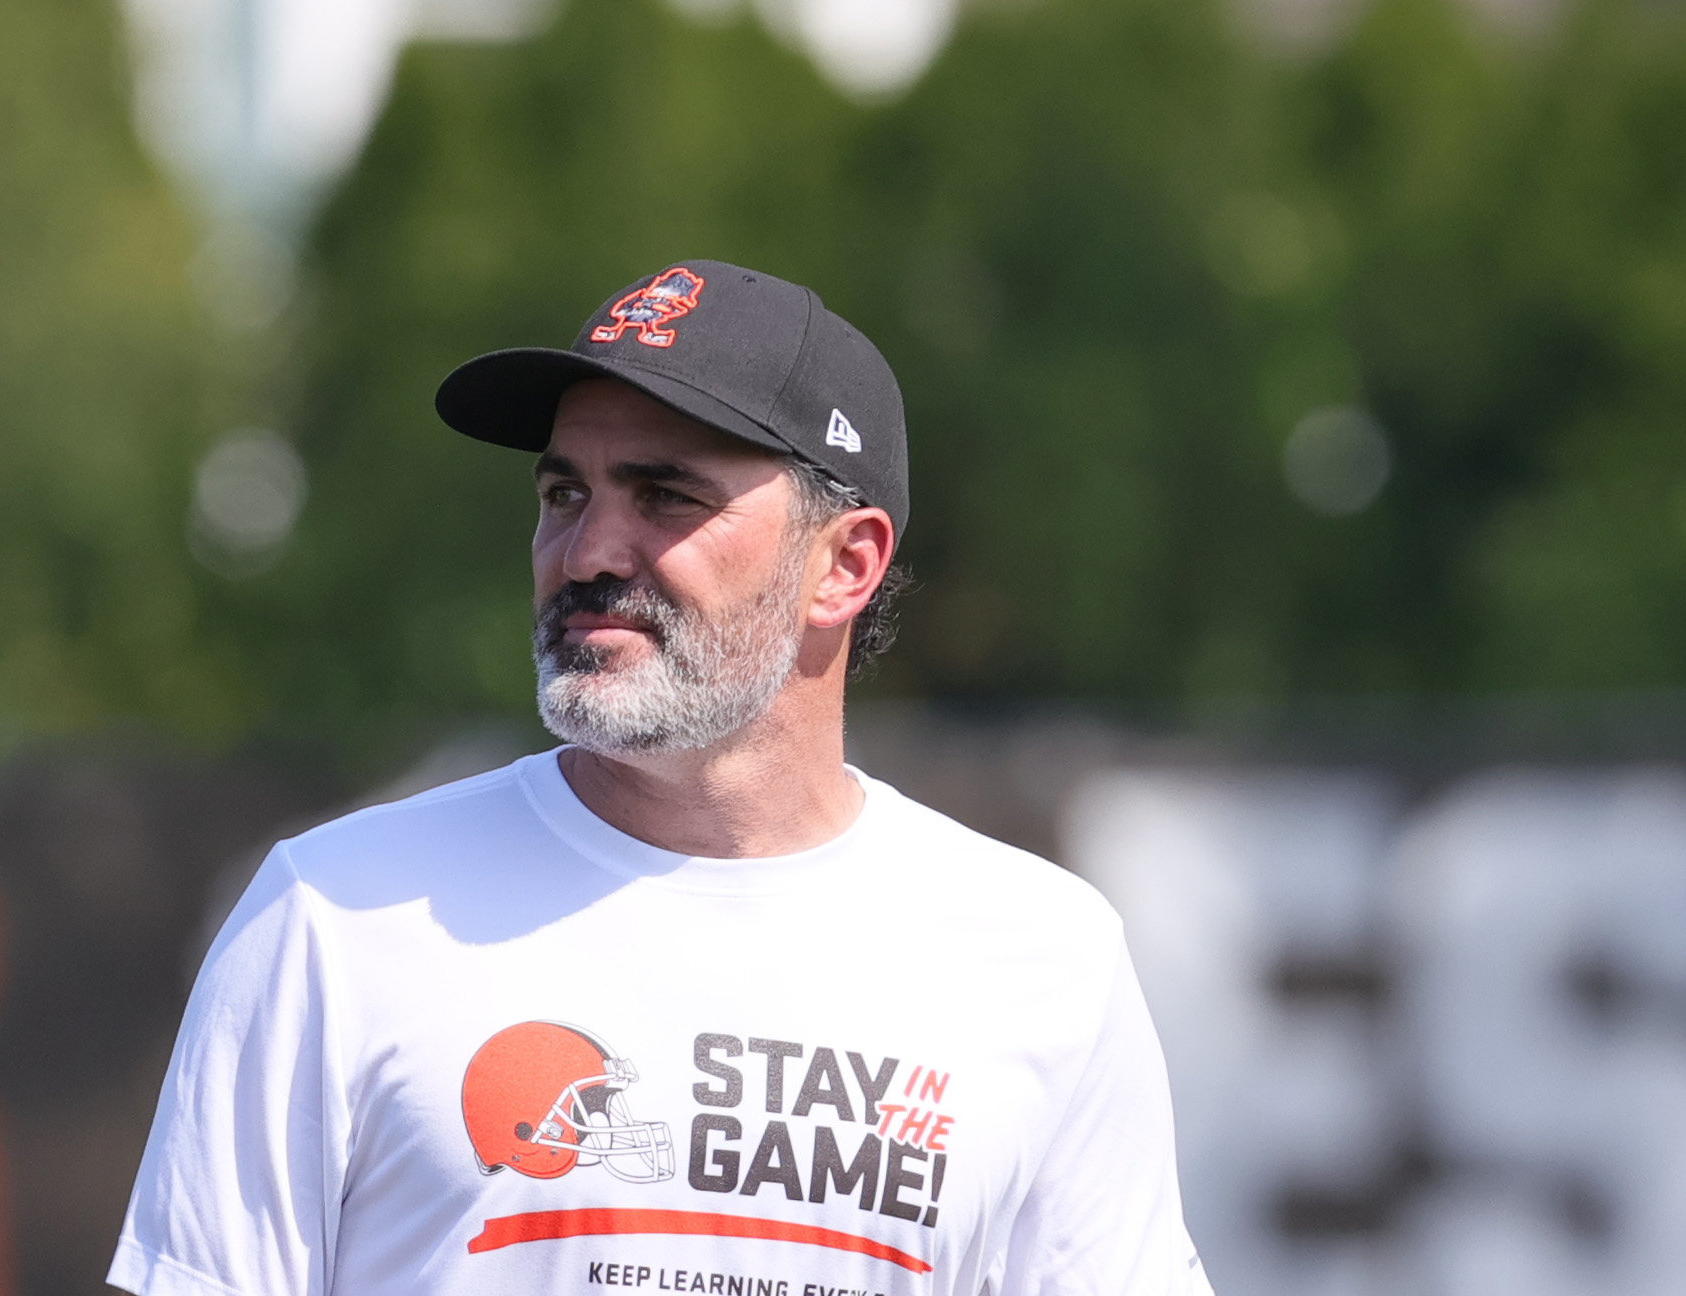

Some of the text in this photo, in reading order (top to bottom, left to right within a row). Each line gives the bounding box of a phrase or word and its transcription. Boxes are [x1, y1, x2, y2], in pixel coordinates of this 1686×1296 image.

[691, 1031, 900, 1126] STAY
[903, 1064, 951, 1105] IN
[877, 1103, 956, 1152] THE
[687, 1112, 948, 1229] GAME!
[588, 1261, 652, 1288] KEEP
